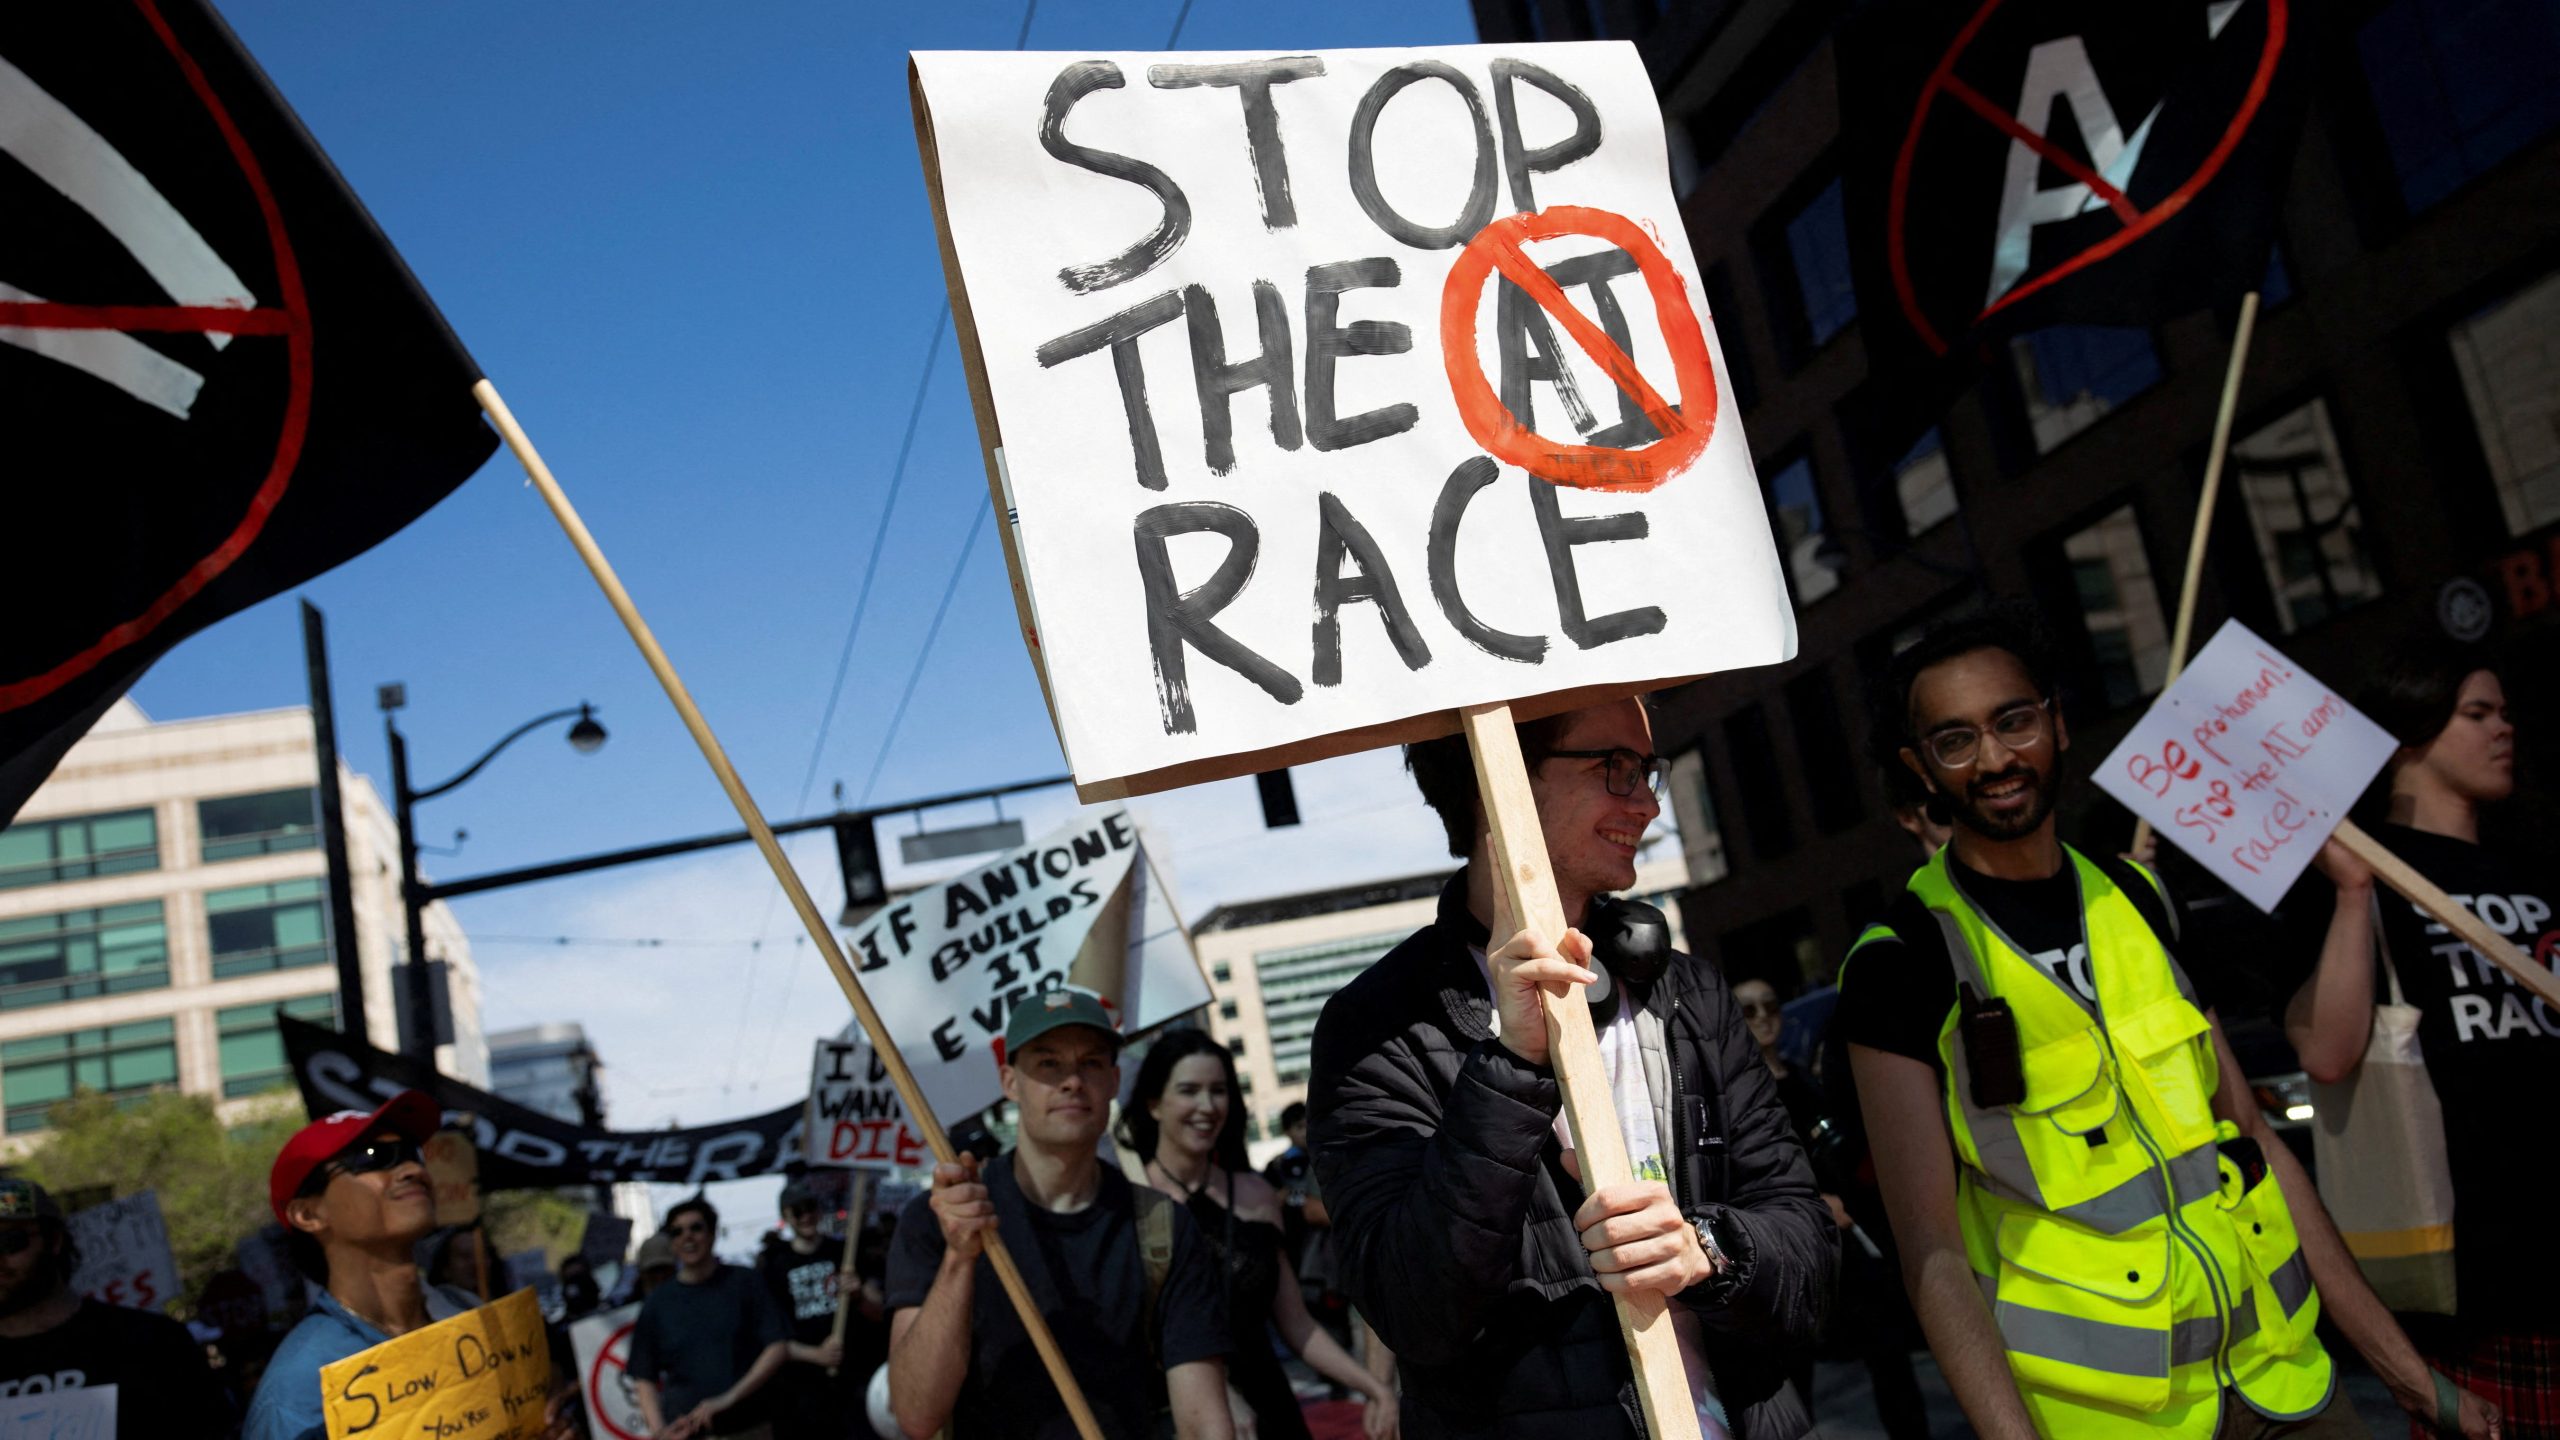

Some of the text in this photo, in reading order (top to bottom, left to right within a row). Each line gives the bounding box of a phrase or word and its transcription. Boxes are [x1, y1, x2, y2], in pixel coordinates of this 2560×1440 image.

[1038, 54, 1604, 296] STOP
[1036, 247, 1684, 491] THE AI
[1134, 454, 1667, 735] RACE
[2127, 739, 2202, 799] Be
[2260, 721, 2314, 767] AI
[2231, 787, 2317, 876] race!
[858, 809, 1136, 973] IF ANYONE
[930, 877, 1100, 983] BUILDS
[984, 936, 1043, 992] IT
[824, 1043, 853, 1082] I
[818, 1088, 904, 1120] WAN
[828, 1119, 927, 1166] DIE
